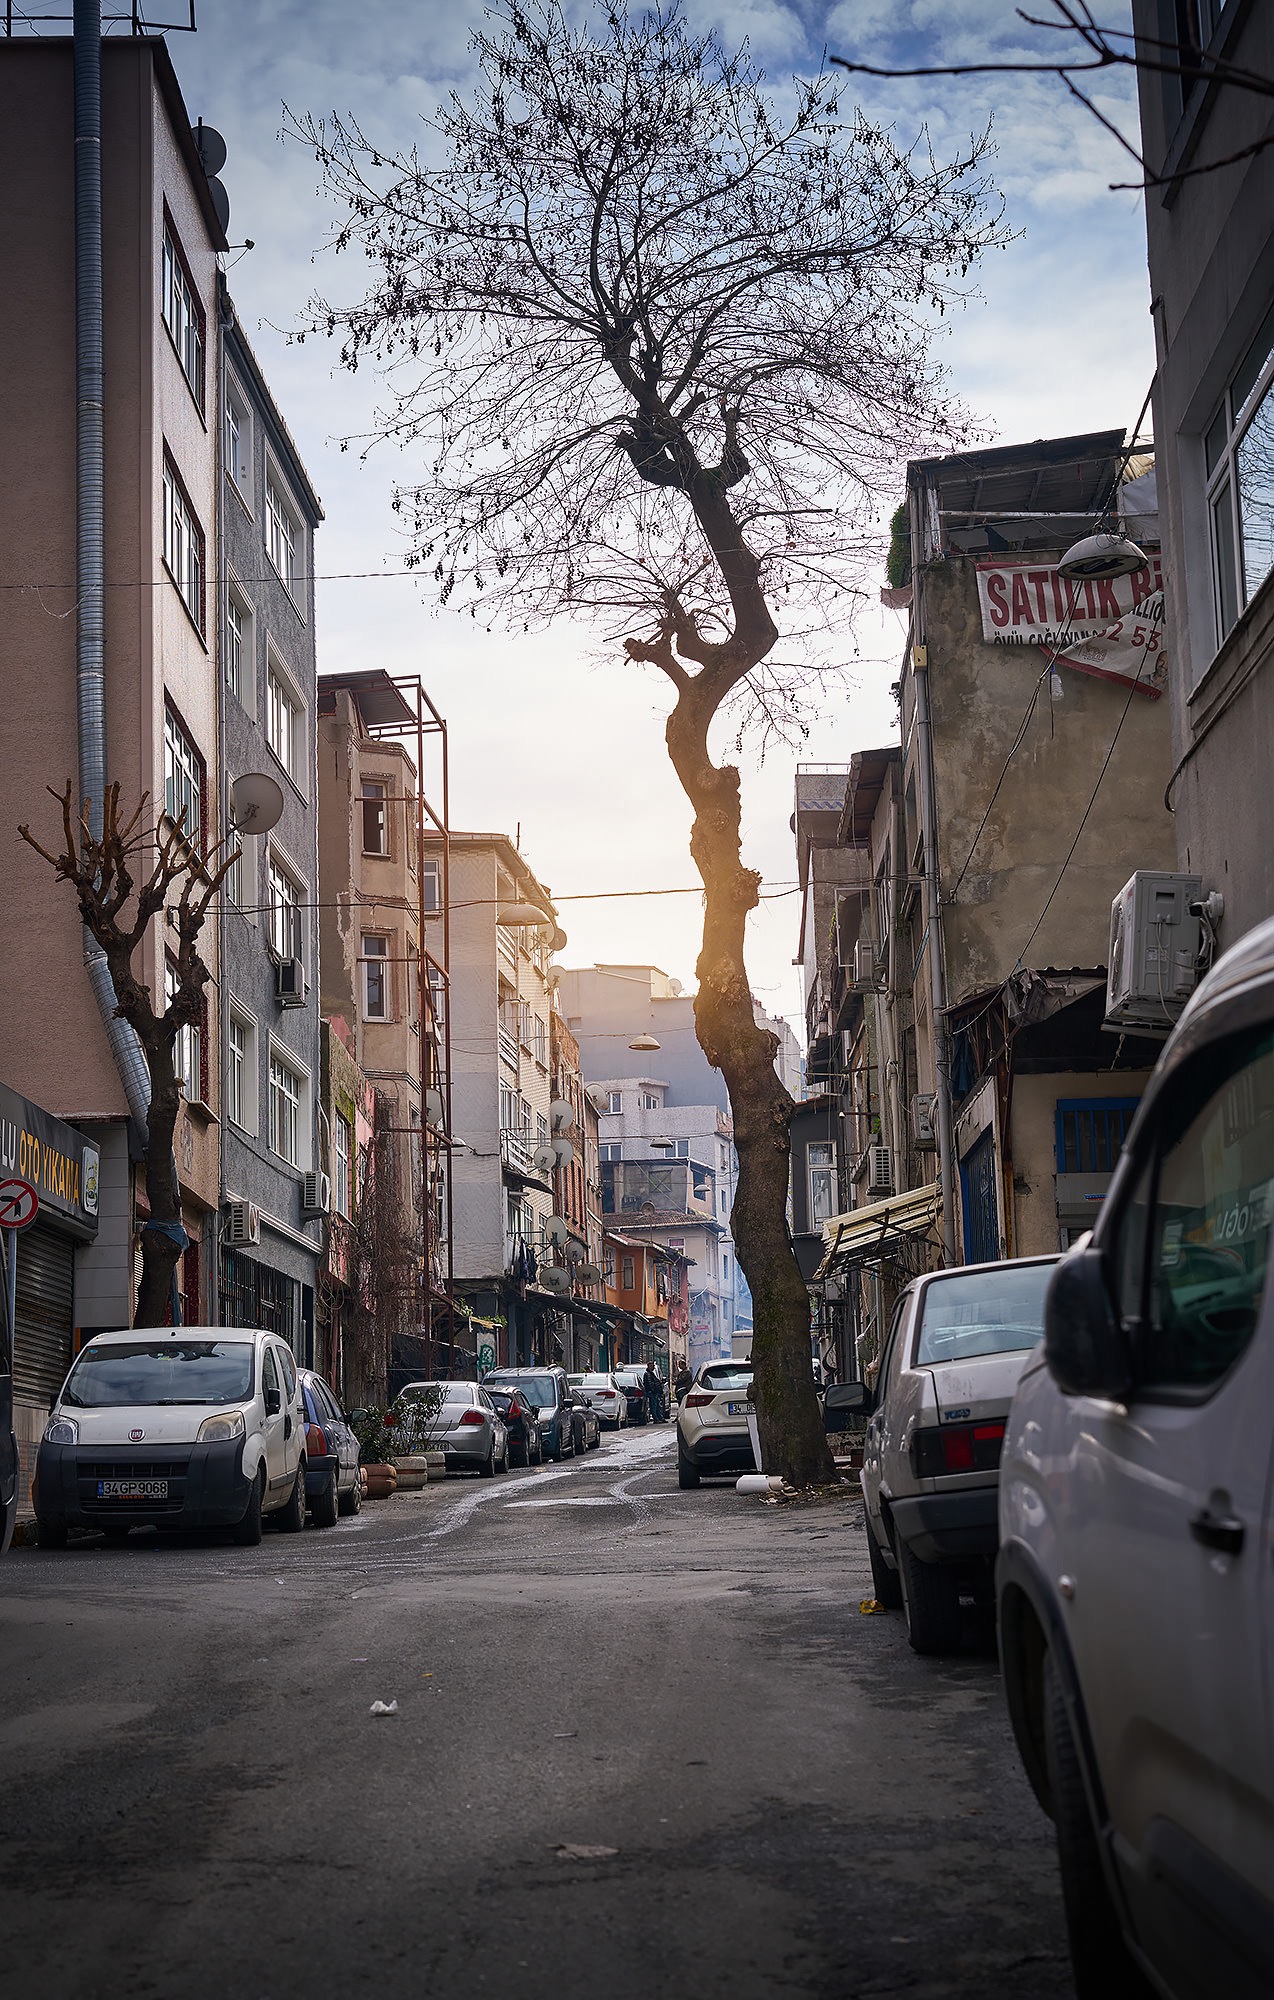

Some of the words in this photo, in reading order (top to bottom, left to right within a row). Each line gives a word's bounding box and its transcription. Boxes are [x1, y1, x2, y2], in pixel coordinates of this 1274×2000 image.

[987, 569, 1122, 627] SATILIK
[1130, 625, 1162, 652] 53
[19, 1128, 40, 1185] OTO
[42, 1143, 80, 1207] YIKAMA
[104, 1482, 118, 1494] 34
[119, 1482, 137, 1494] GP
[138, 1482, 167, 1494] 9068
